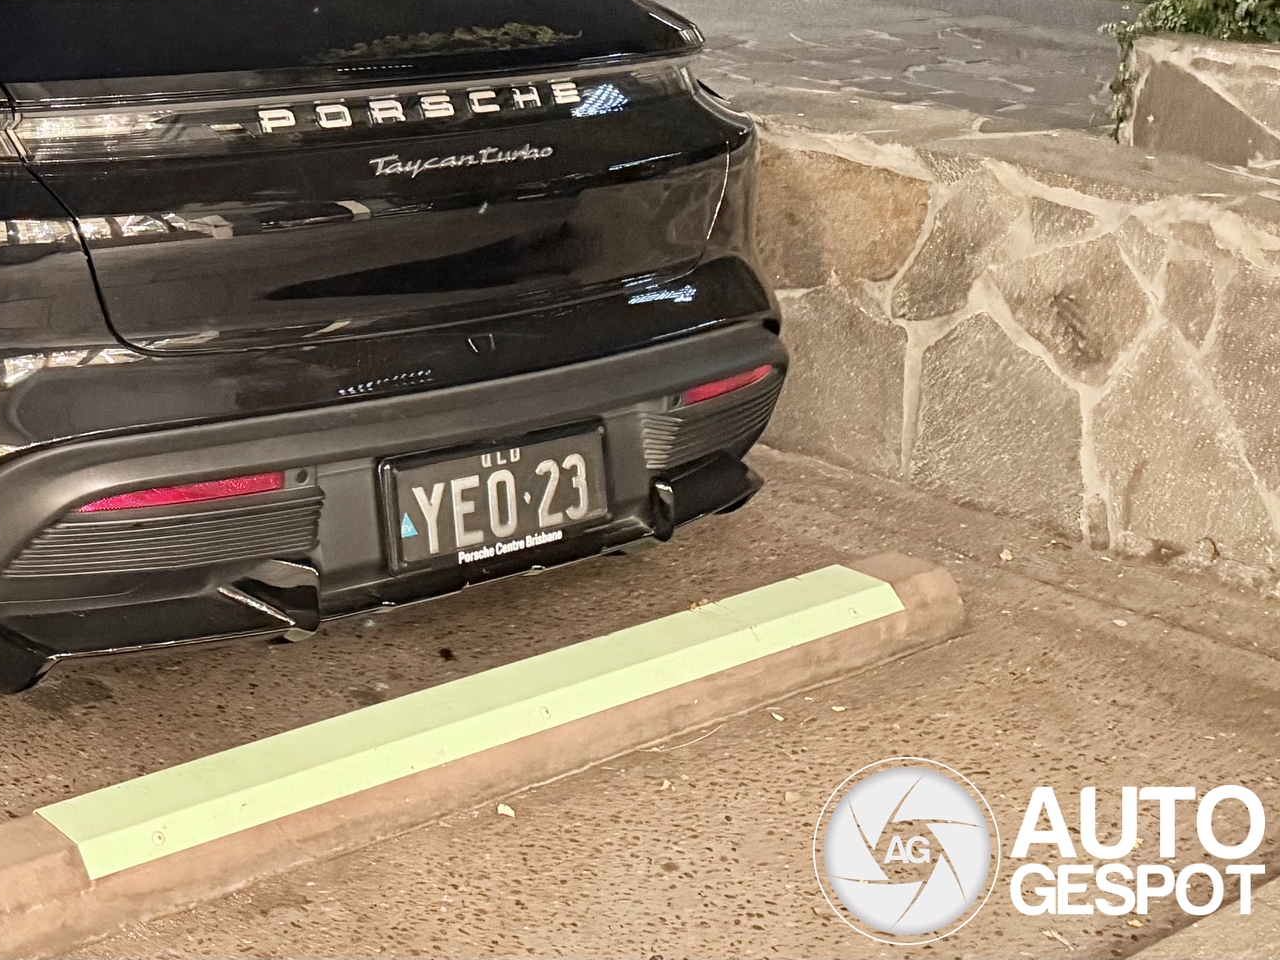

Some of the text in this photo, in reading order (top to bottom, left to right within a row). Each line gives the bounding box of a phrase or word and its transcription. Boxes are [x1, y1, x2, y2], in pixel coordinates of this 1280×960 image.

[257, 81, 582, 134] PORSCHE
[369, 153, 479, 179] Taycan
[480, 447, 521, 468] QLD
[457, 529, 563, 565] Porsche Centre Brisbane
